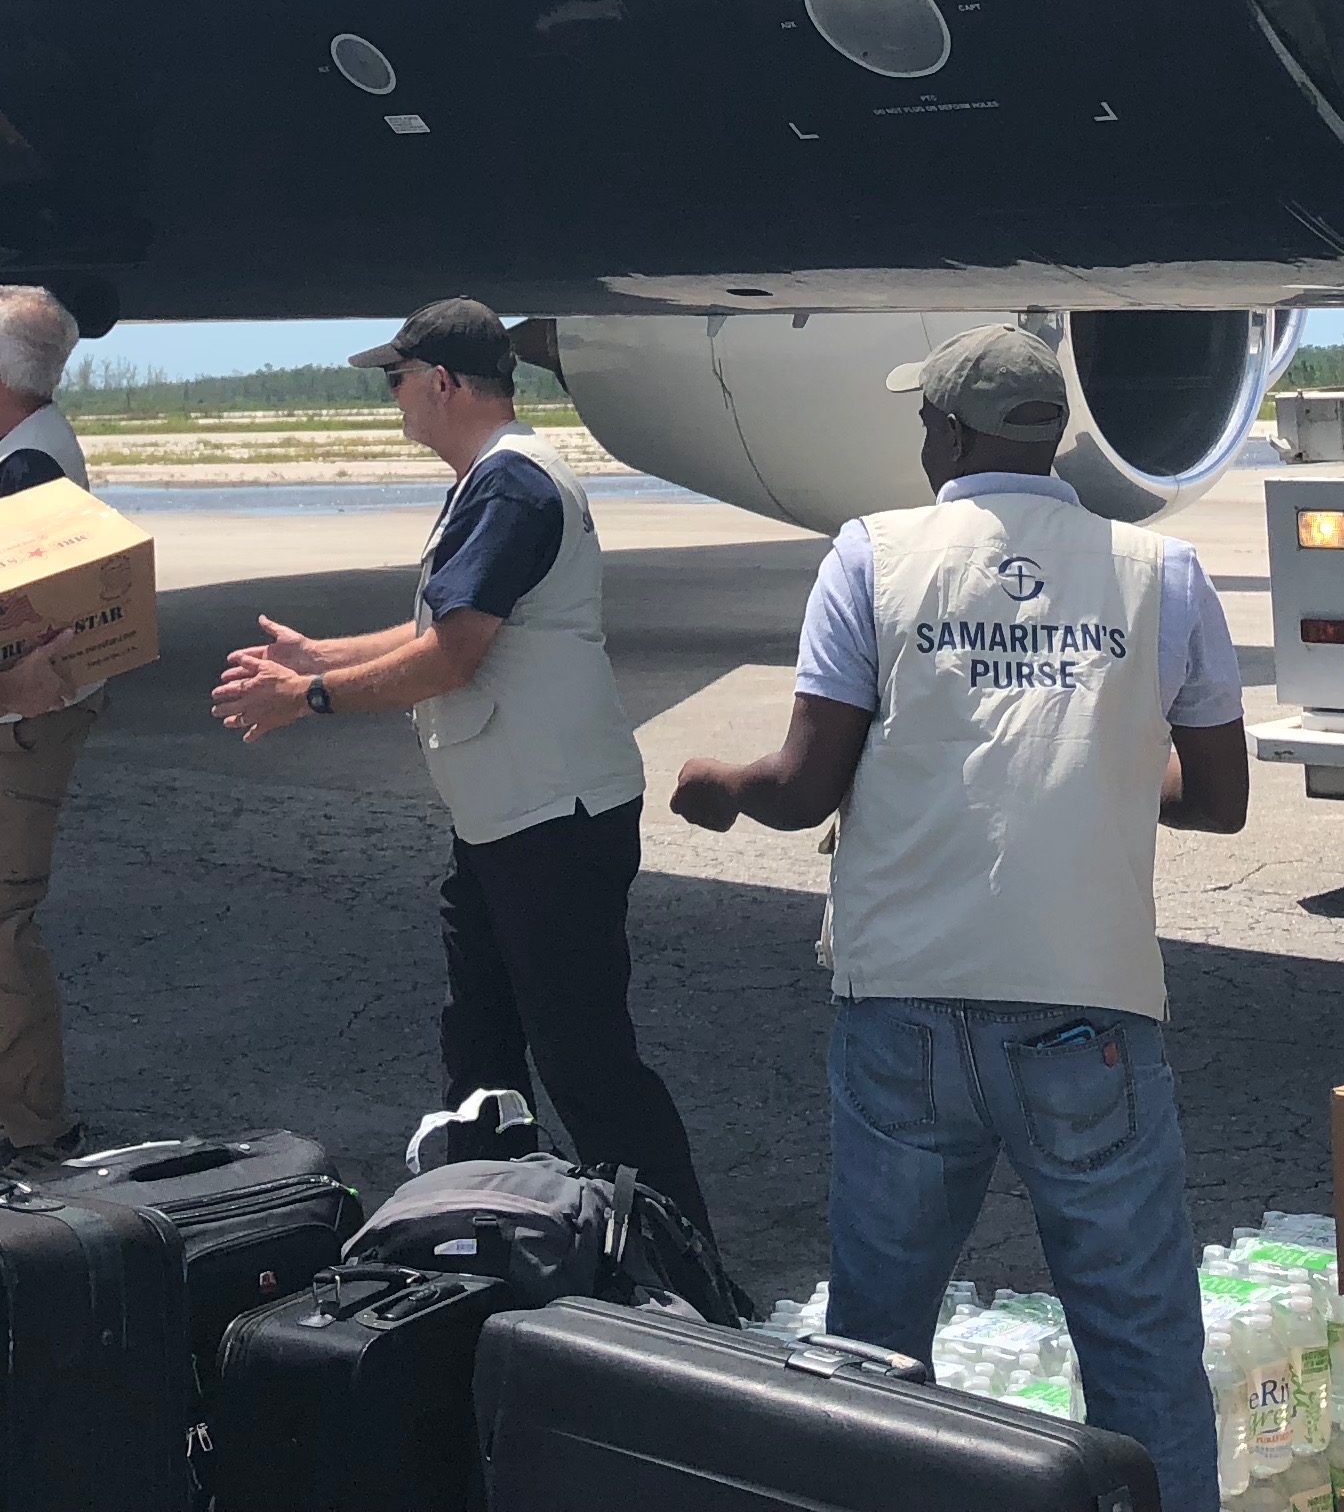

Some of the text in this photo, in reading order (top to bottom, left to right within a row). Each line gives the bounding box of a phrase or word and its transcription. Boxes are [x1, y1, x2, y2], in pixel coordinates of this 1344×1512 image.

[958, 3, 981, 12] CAPT
[74, 606, 124, 634] STAR
[916, 620, 1128, 660] SAMARITAN'S
[970, 659, 1079, 690] PURSE
